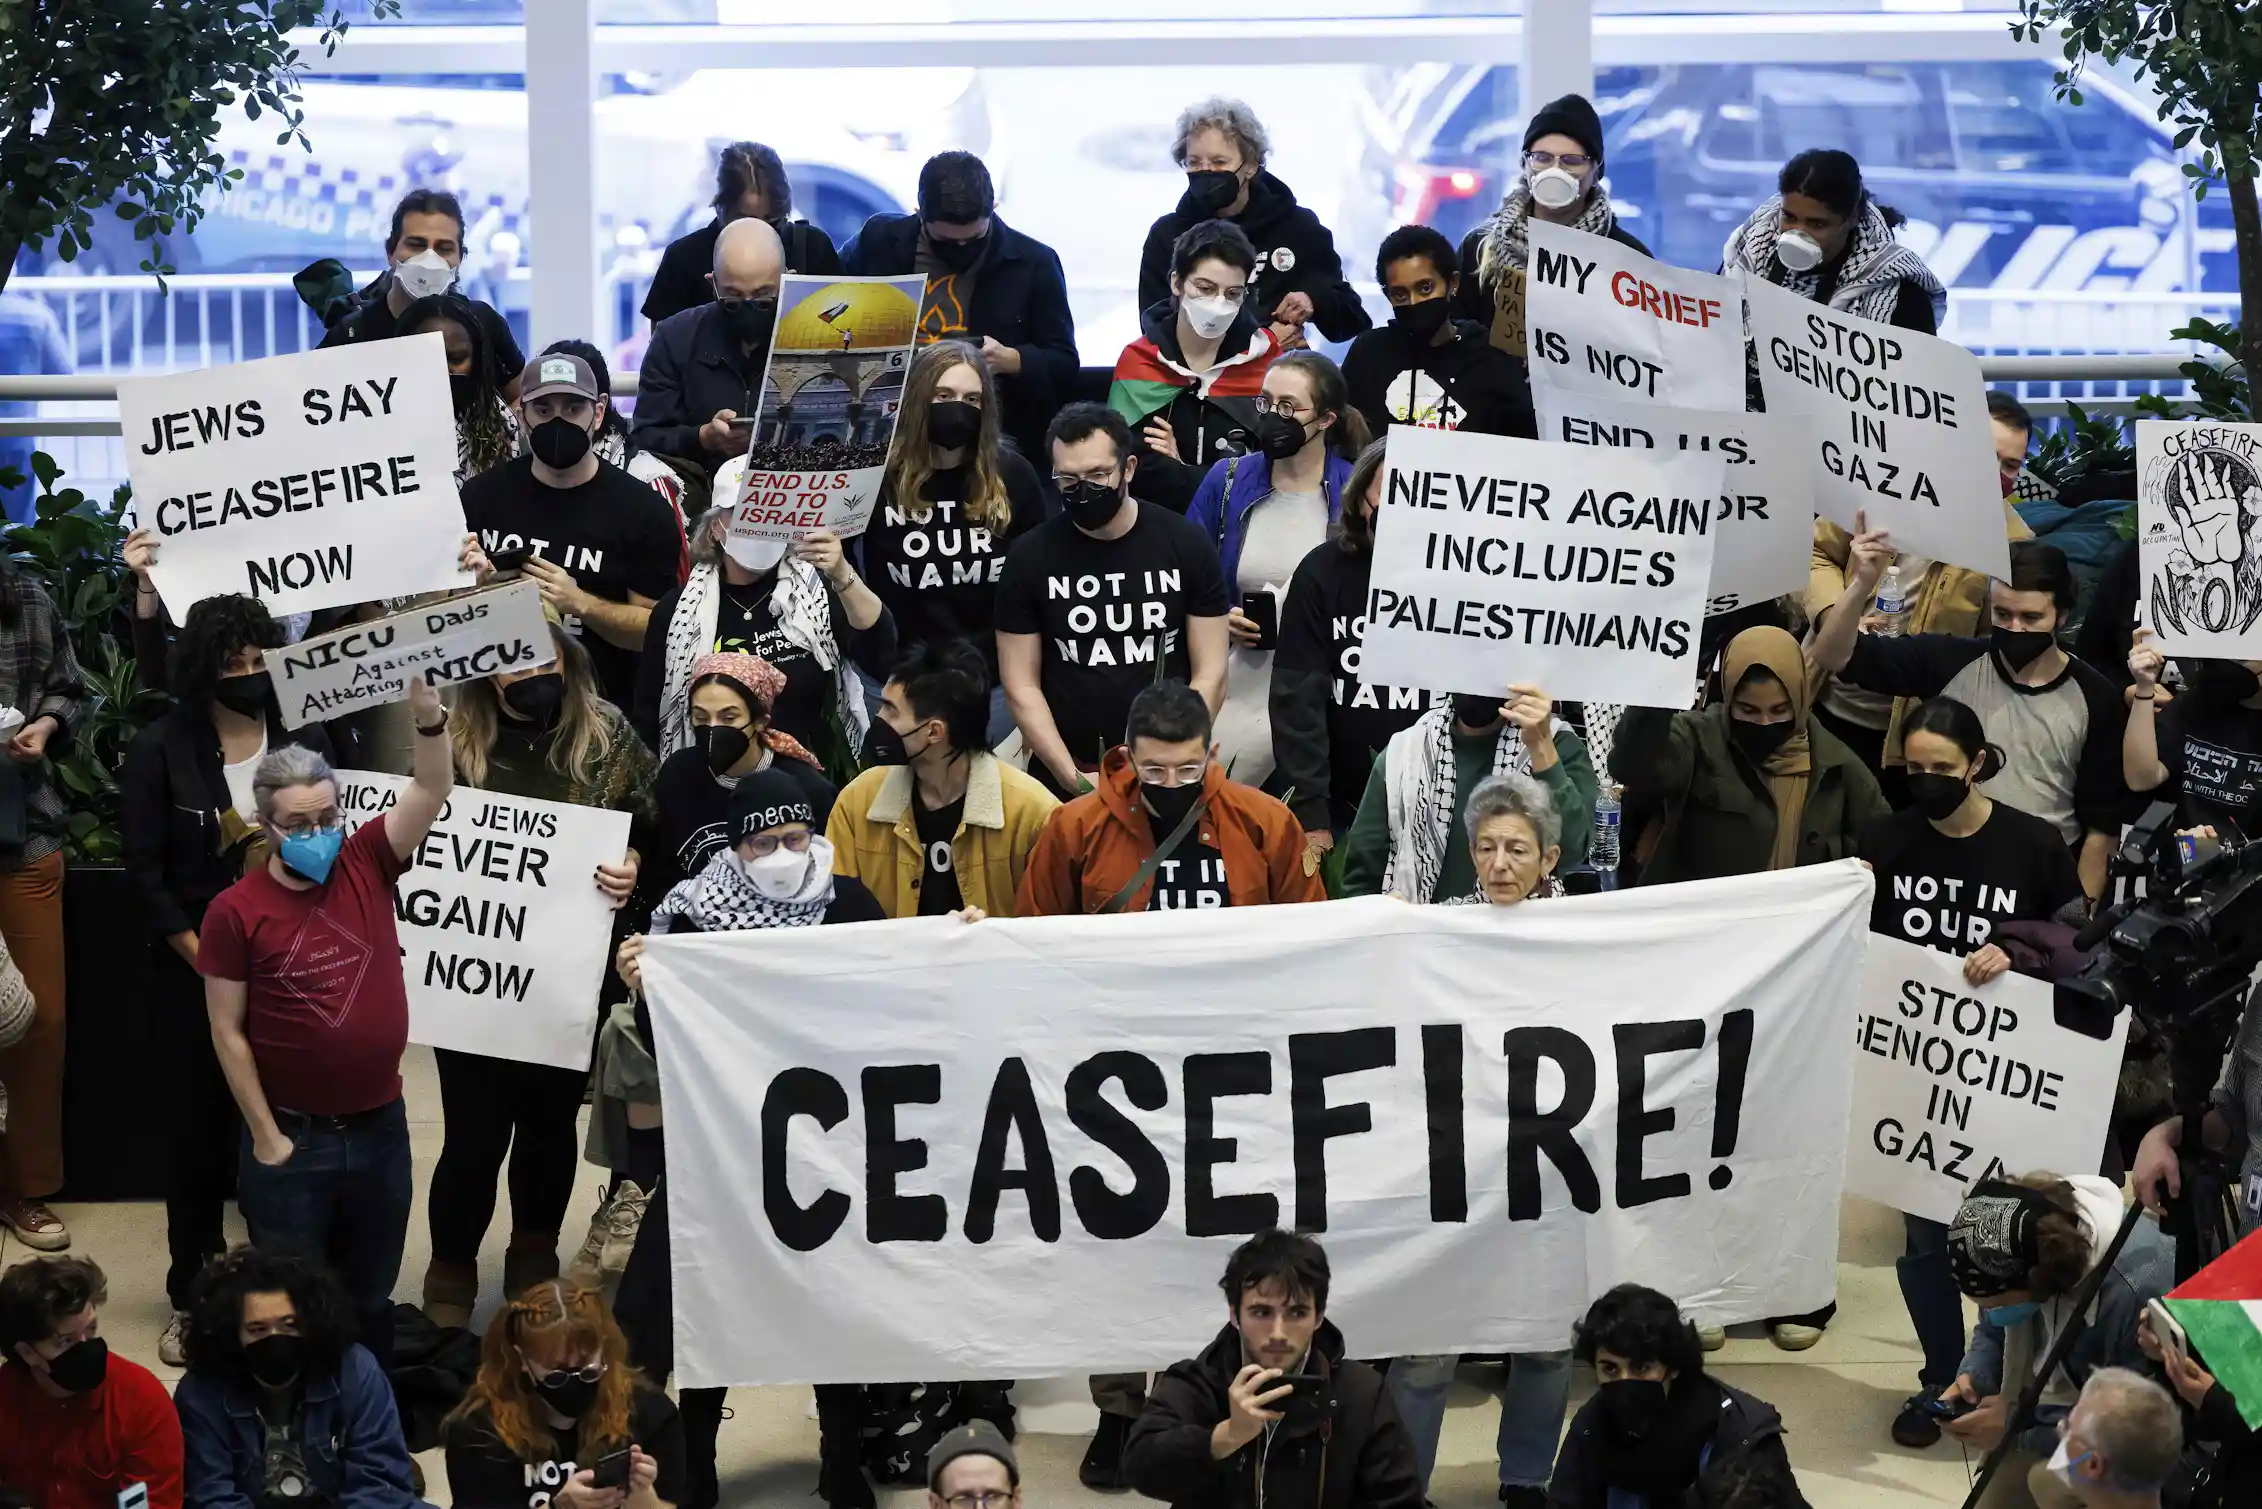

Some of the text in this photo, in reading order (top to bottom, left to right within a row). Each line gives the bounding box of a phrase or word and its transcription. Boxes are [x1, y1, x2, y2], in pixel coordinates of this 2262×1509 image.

[1537, 247, 1597, 295] MY
[1611, 270, 1721, 328] GRIEF
[1807, 314, 1903, 370] STOP
[1535, 328, 1570, 365] IS
[1586, 344, 1663, 398] NOT
[1770, 337, 1958, 429] GENOCIDE
[141, 377, 398, 455] JEWS SAY
[1562, 415, 1655, 449] END
[1851, 410, 1887, 453] IN
[2164, 428, 2262, 463] CEASEFIRE
[748, 473, 850, 491] END U.S.
[1821, 440, 1941, 507] GAZA
[157, 455, 421, 536] CEASEFIRE
[742, 492, 828, 510] AID TO
[884, 500, 956, 527] NOT
[1387, 467, 1711, 537] NEVER AGAIN
[739, 507, 826, 528] ISRAEL
[563, 544, 603, 573] IN
[902, 526, 993, 559] OUR
[1425, 532, 1676, 588] INCLUDES
[245, 544, 353, 598] NOW
[886, 556, 1006, 590] NAME
[1048, 568, 1182, 599] NOT IN
[1067, 601, 1167, 634] OUR
[1369, 588, 1691, 660] PALESTINIANS
[284, 603, 489, 680] NICU Dads
[755, 644, 774, 657] for
[1053, 627, 1179, 667] NAME
[301, 639, 536, 719] Attacking NICUs
[351, 645, 446, 685] Against
[2218, 789, 2235, 802] THE
[472, 803, 557, 838] JEWS
[416, 830, 549, 887] EVER
[1894, 875, 2017, 914] NOT IN
[1902, 907, 1992, 946] OUR
[424, 950, 535, 1002] NOW
[1898, 979, 2018, 1042] STOP
[1926, 1083, 1972, 1131] IN
[761, 1008, 1754, 1252] CEASEFIRE!
[524, 1460, 578, 1488] NOT
